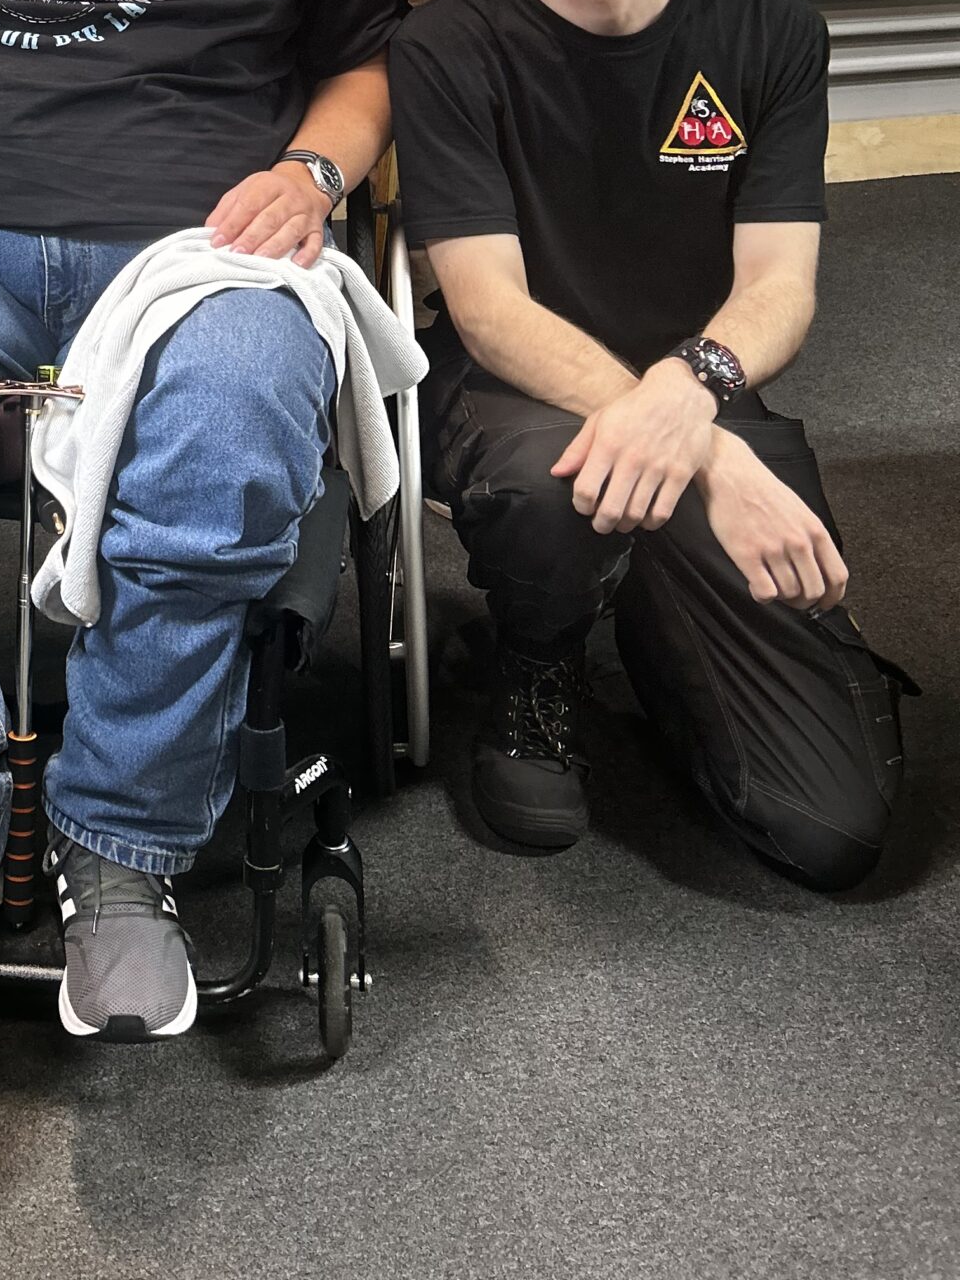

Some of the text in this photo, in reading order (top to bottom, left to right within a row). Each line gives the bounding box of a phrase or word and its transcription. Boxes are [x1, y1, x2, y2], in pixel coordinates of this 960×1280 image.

[53, 25, 104, 46] DIE
[104, 2, 147, 32] LA
[659, 155, 735, 163] Stephen Harrison
